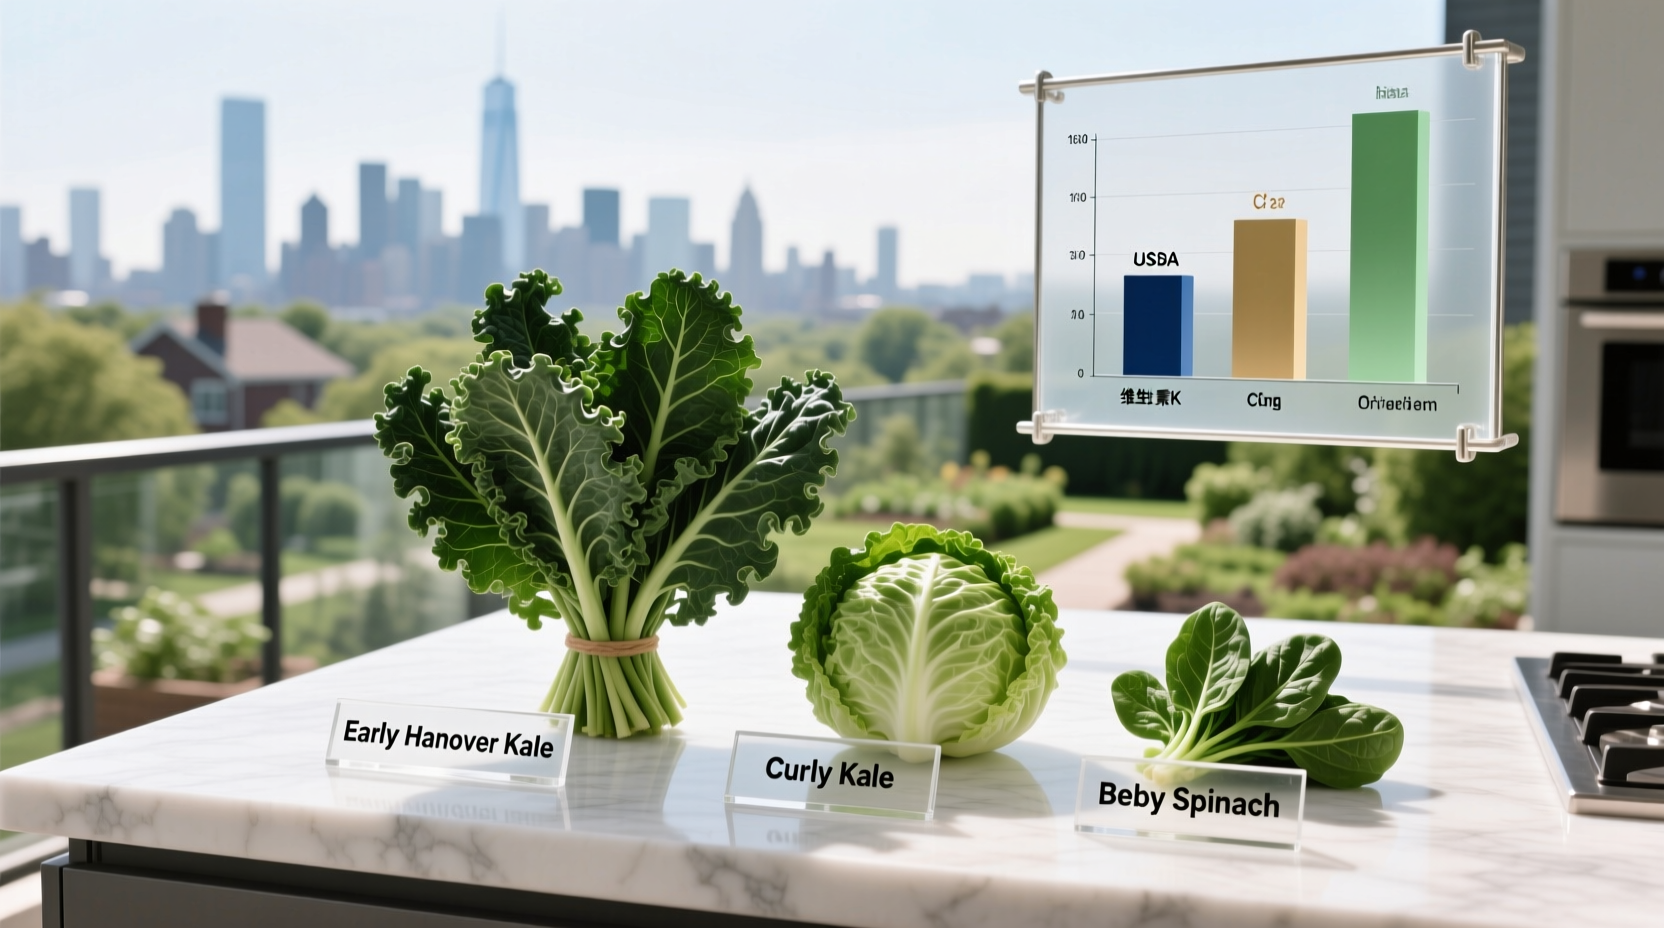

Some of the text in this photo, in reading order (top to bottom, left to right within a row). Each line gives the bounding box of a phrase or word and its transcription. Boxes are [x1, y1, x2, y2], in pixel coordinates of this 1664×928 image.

[1077, 368, 1085, 378] 0
[343, 719, 555, 759] Early Hanover Kale
[765, 756, 895, 789] Curly Kale
[1098, 781, 1281, 818] Beby Spinach
